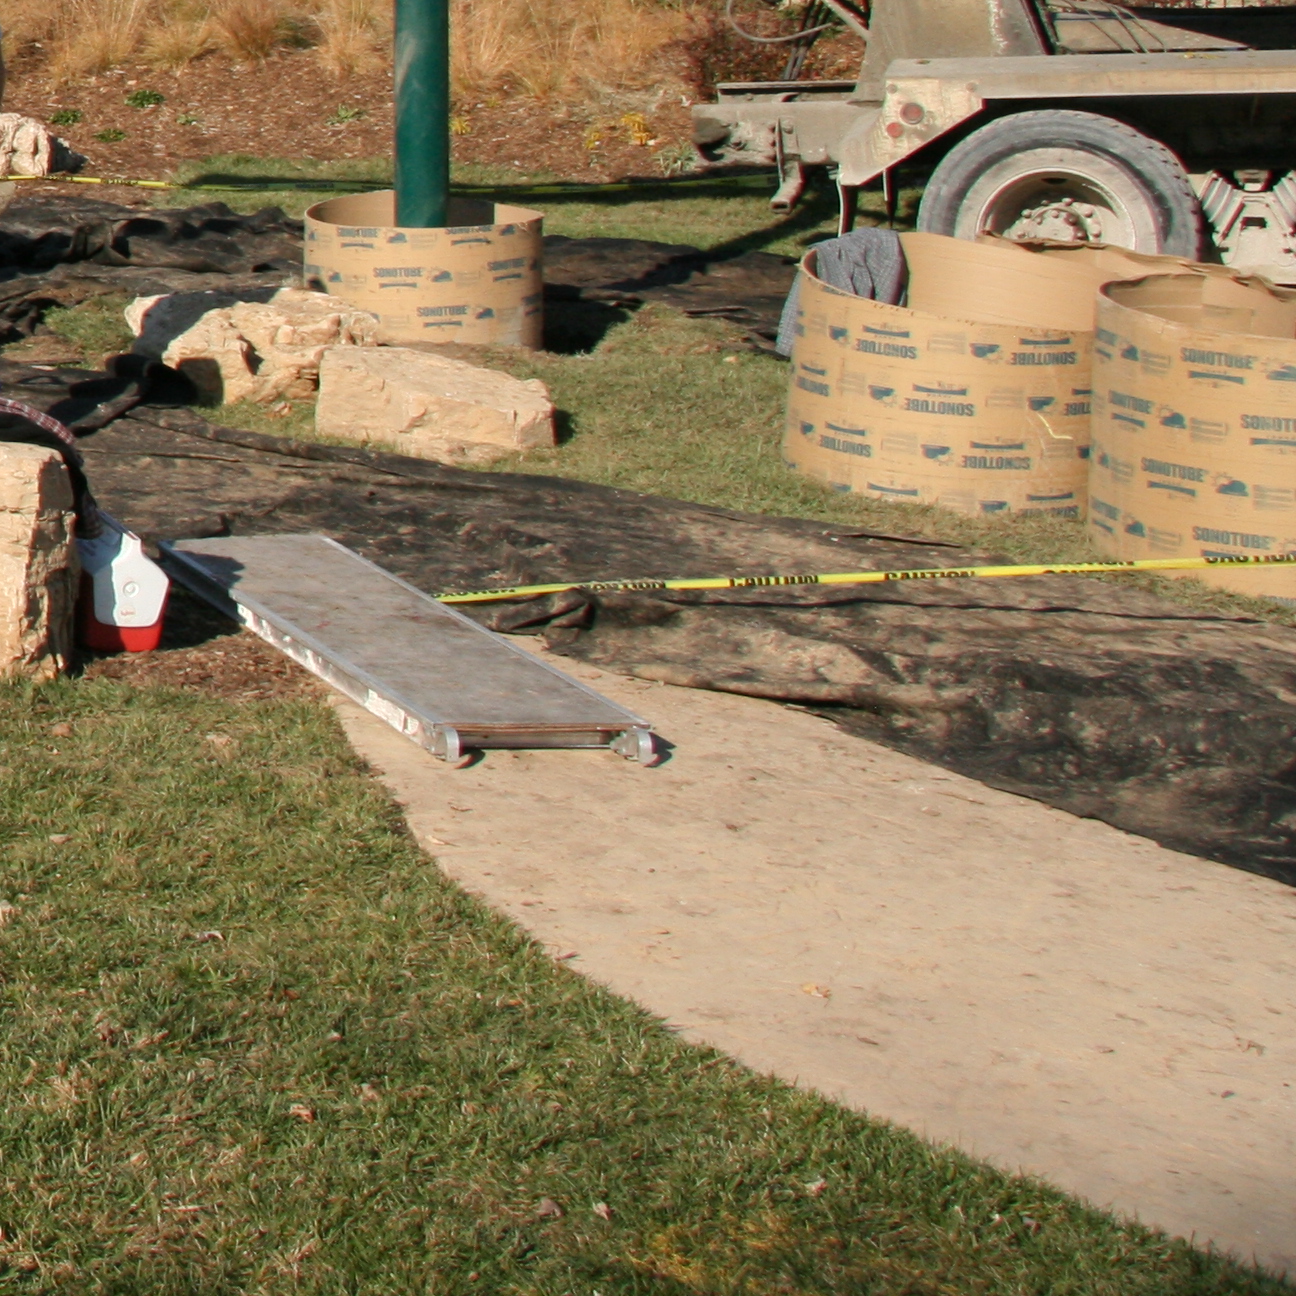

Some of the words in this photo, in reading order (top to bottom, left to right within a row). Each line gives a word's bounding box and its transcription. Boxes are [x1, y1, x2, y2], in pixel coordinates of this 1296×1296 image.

[373, 267, 424, 278] SONOTUBE
[417, 305, 468, 317] SONOTUBE
[855, 338, 917, 360] SONOTUBE
[1010, 351, 1077, 366] SONOTUBE
[1181, 347, 1255, 370] SONOTUBE
[904, 397, 975, 417] SONOTUBE
[961, 455, 1031, 471] SONOTUBE
[1141, 457, 1207, 483] SONOTUBE
[1192, 525, 1272, 550] SONOTUBE
